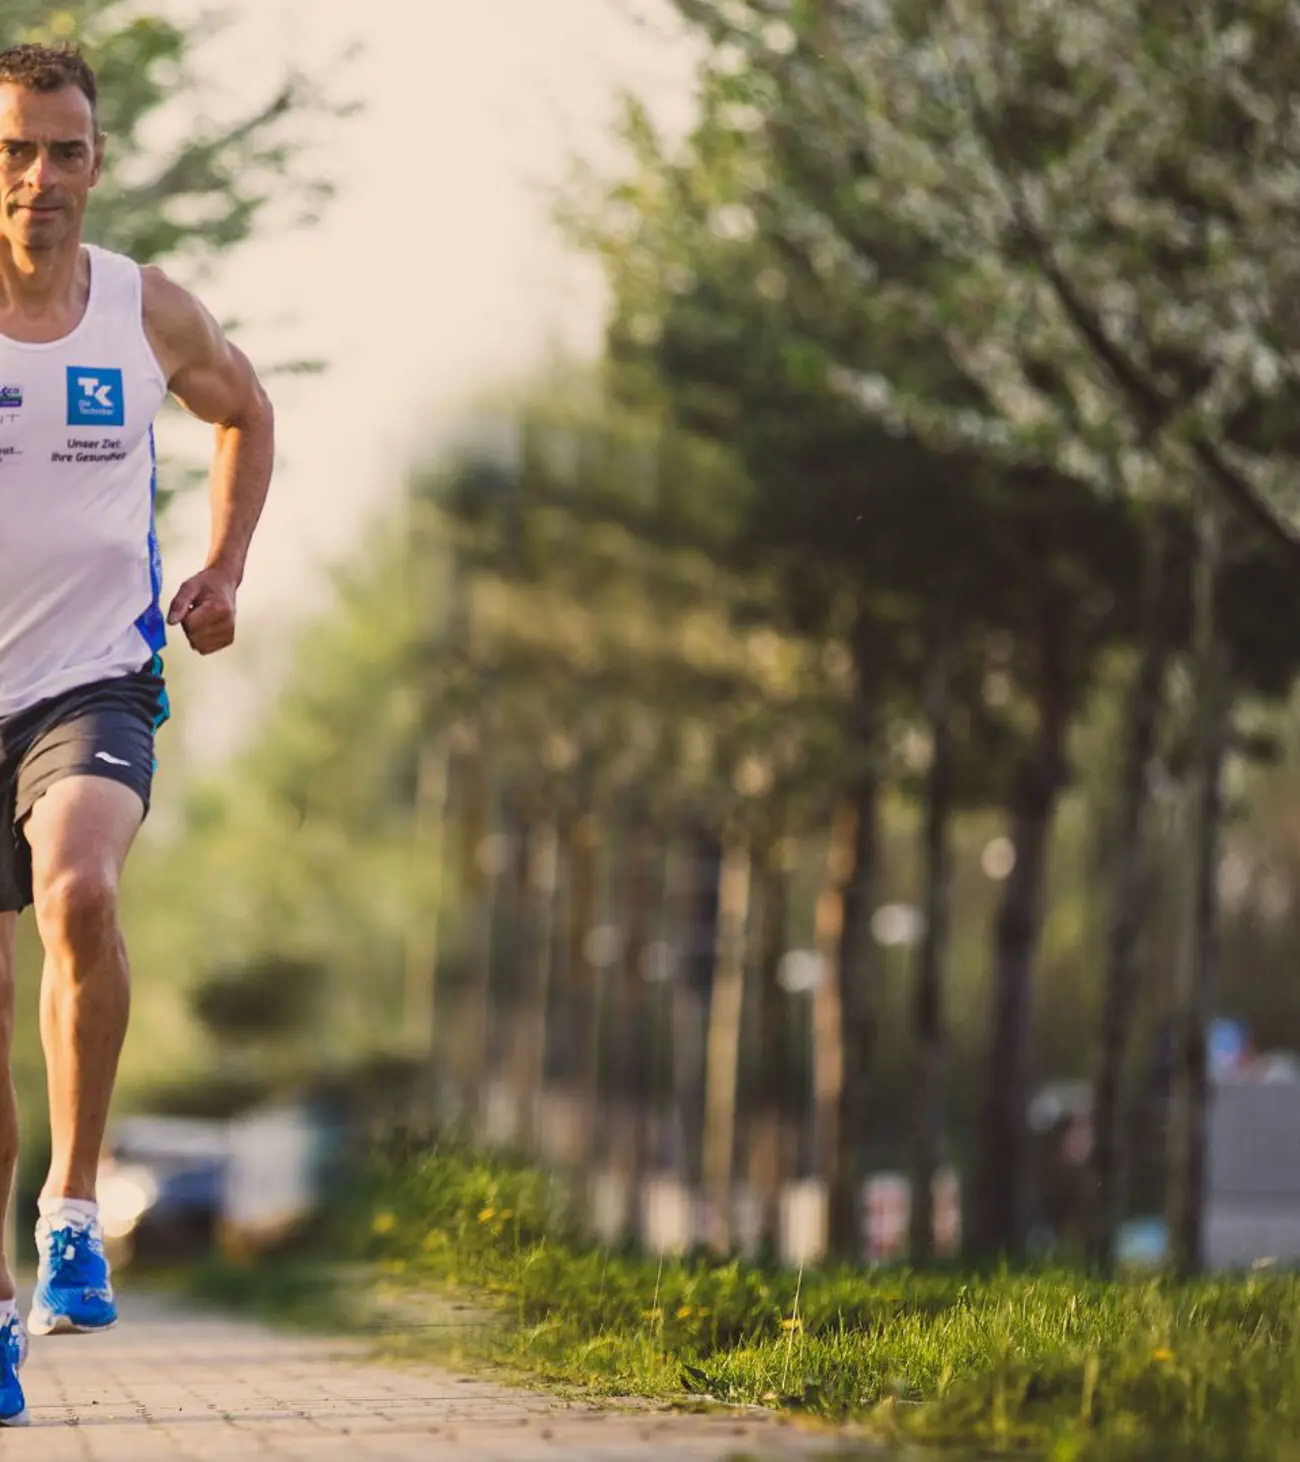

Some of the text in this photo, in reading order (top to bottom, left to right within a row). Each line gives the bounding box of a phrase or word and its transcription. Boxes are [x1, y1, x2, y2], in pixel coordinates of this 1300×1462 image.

[77, 377, 114, 407] TK
[67, 438, 99, 449] Unser
[51, 452, 73, 462] Ihre
